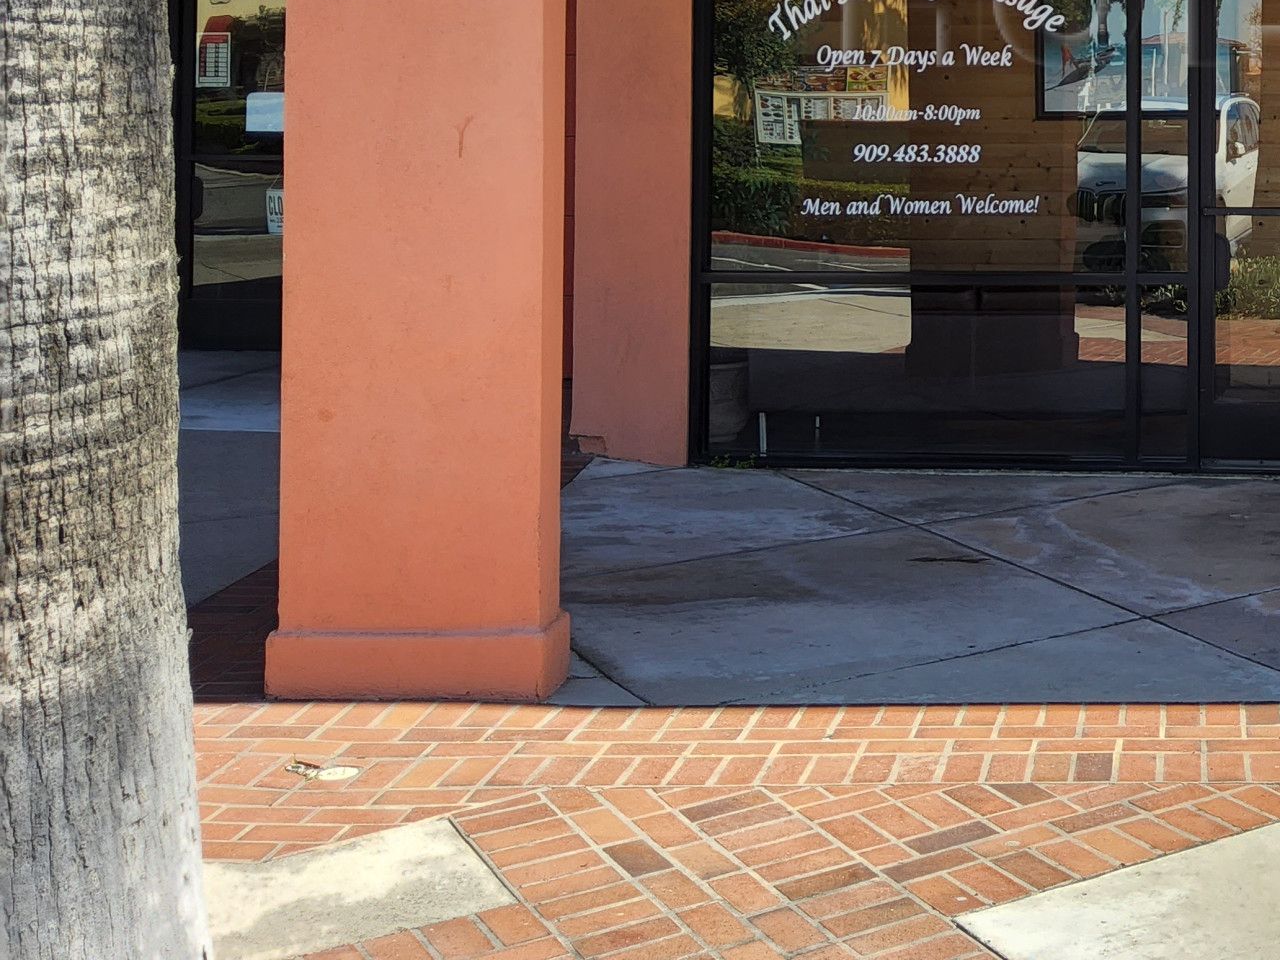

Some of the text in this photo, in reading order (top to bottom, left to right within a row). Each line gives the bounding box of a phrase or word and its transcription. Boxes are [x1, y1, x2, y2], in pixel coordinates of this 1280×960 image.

[816, 43, 1014, 73] Open 7 Days a Week
[851, 104, 981, 126] 10:00am-8:00pm
[852, 143, 982, 164] 909.483.3888
[800, 193, 1040, 216] Men and Women Welcome!
